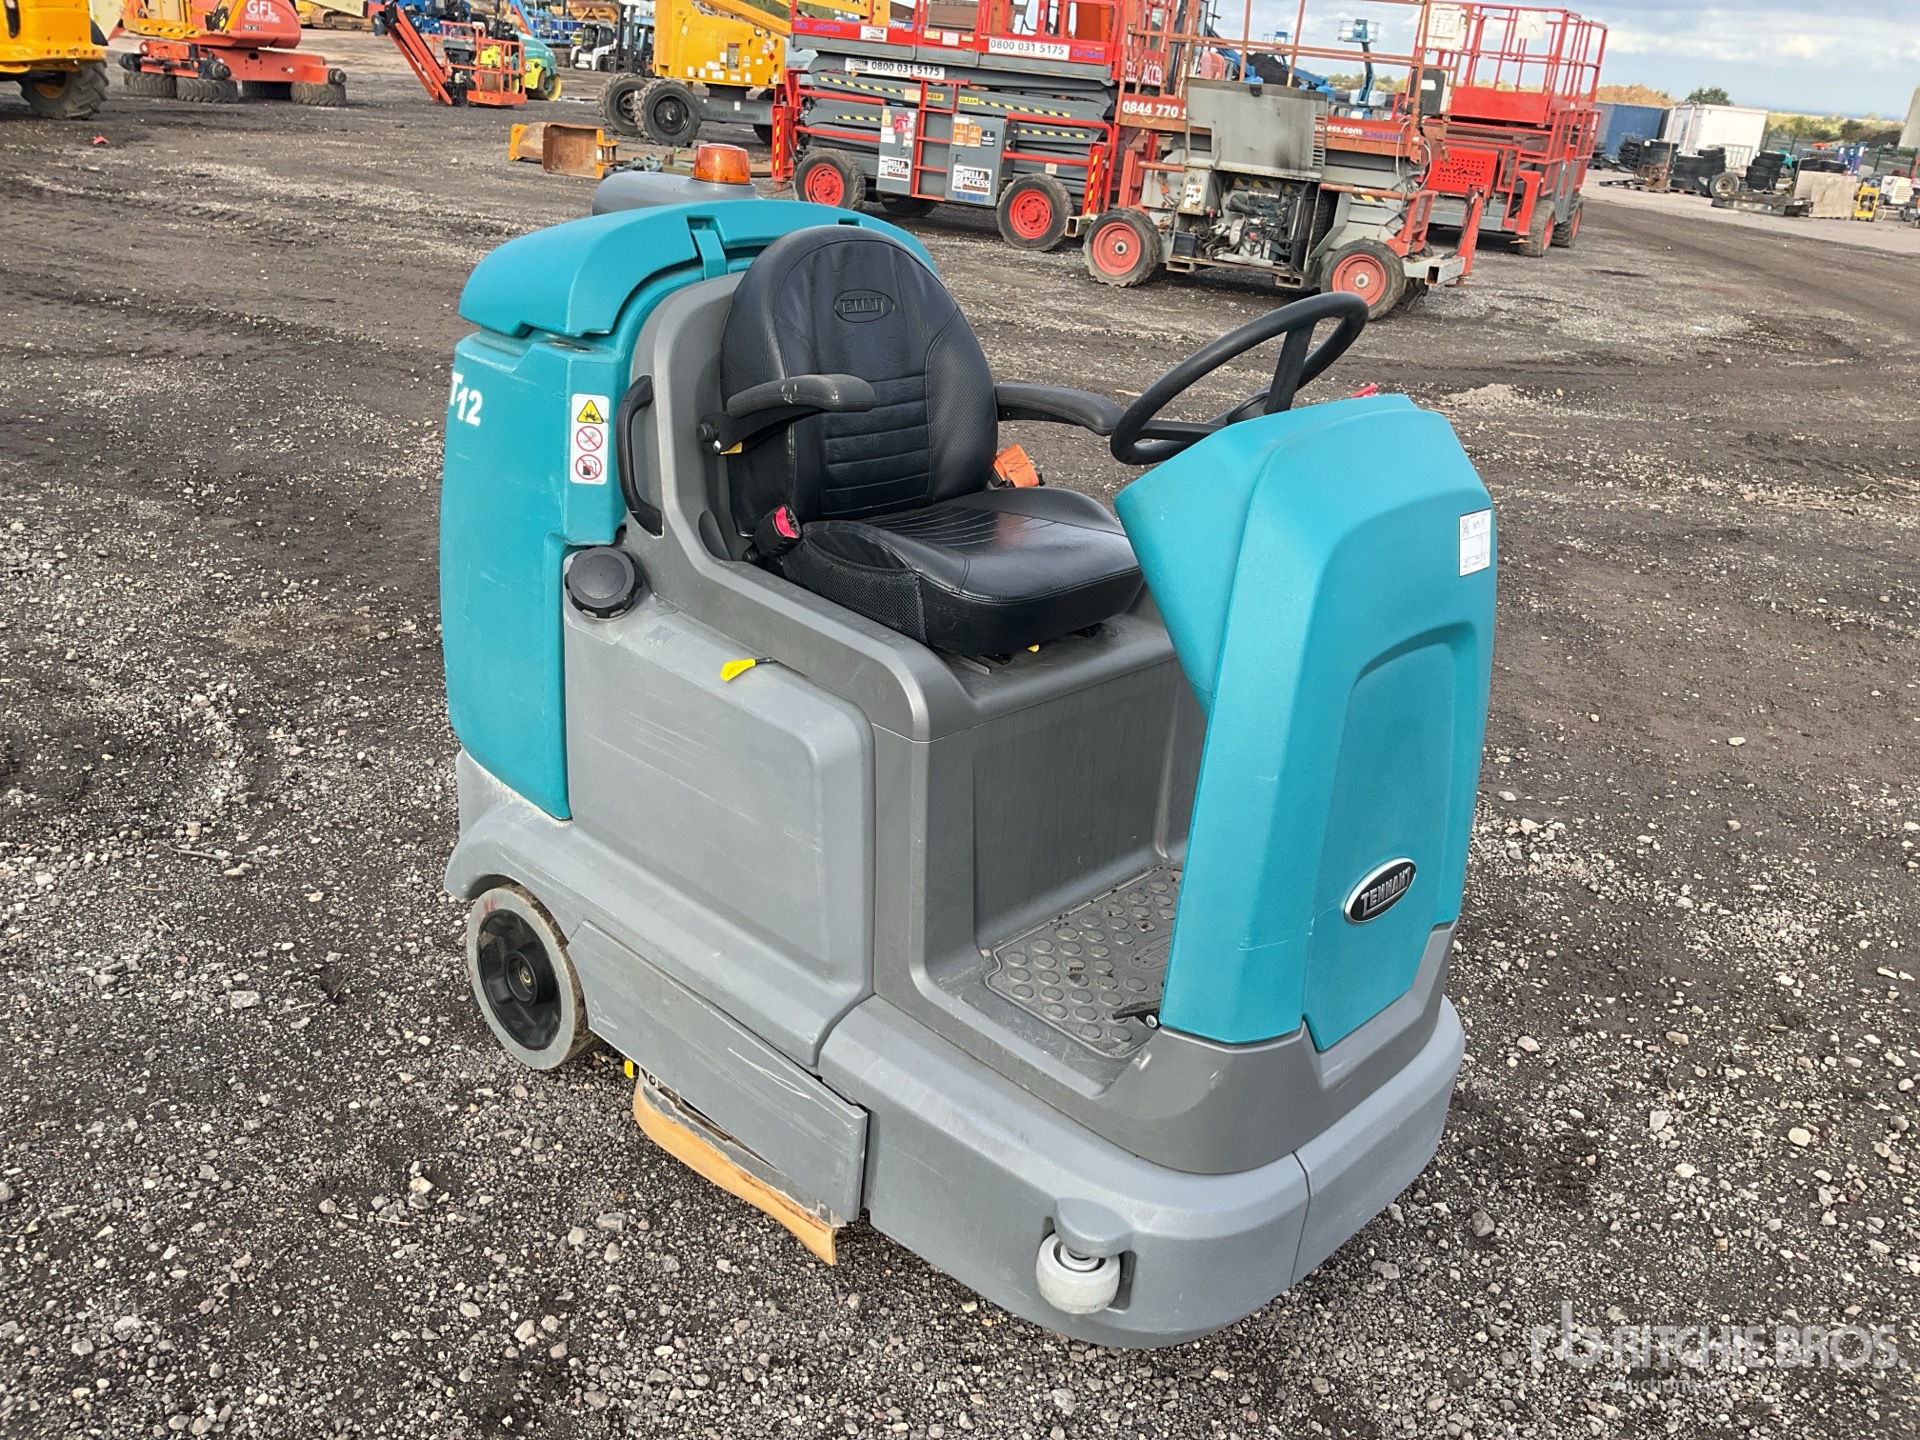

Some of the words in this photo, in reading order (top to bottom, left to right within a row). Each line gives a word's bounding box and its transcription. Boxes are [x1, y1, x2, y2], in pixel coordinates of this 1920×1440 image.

[247, 0, 276, 16] GFL
[990, 39, 1015, 50] 0800
[1018, 42, 1036, 52] 031
[1039, 44, 1065, 55] 5175
[871, 61, 894, 72] 0800
[897, 63, 914, 73] 031
[916, 65, 940, 76] 5175
[1122, 101, 1152, 115] 0844
[1155, 104, 1179, 118] 770
[887, 159, 906, 168] BELLA
[887, 166, 909, 175] ACCESS
[963, 169, 986, 180] BELLA
[963, 178, 990, 188] ACCESS
[450, 371, 483, 427] T12
[1361, 866, 1411, 917] TENNANT
